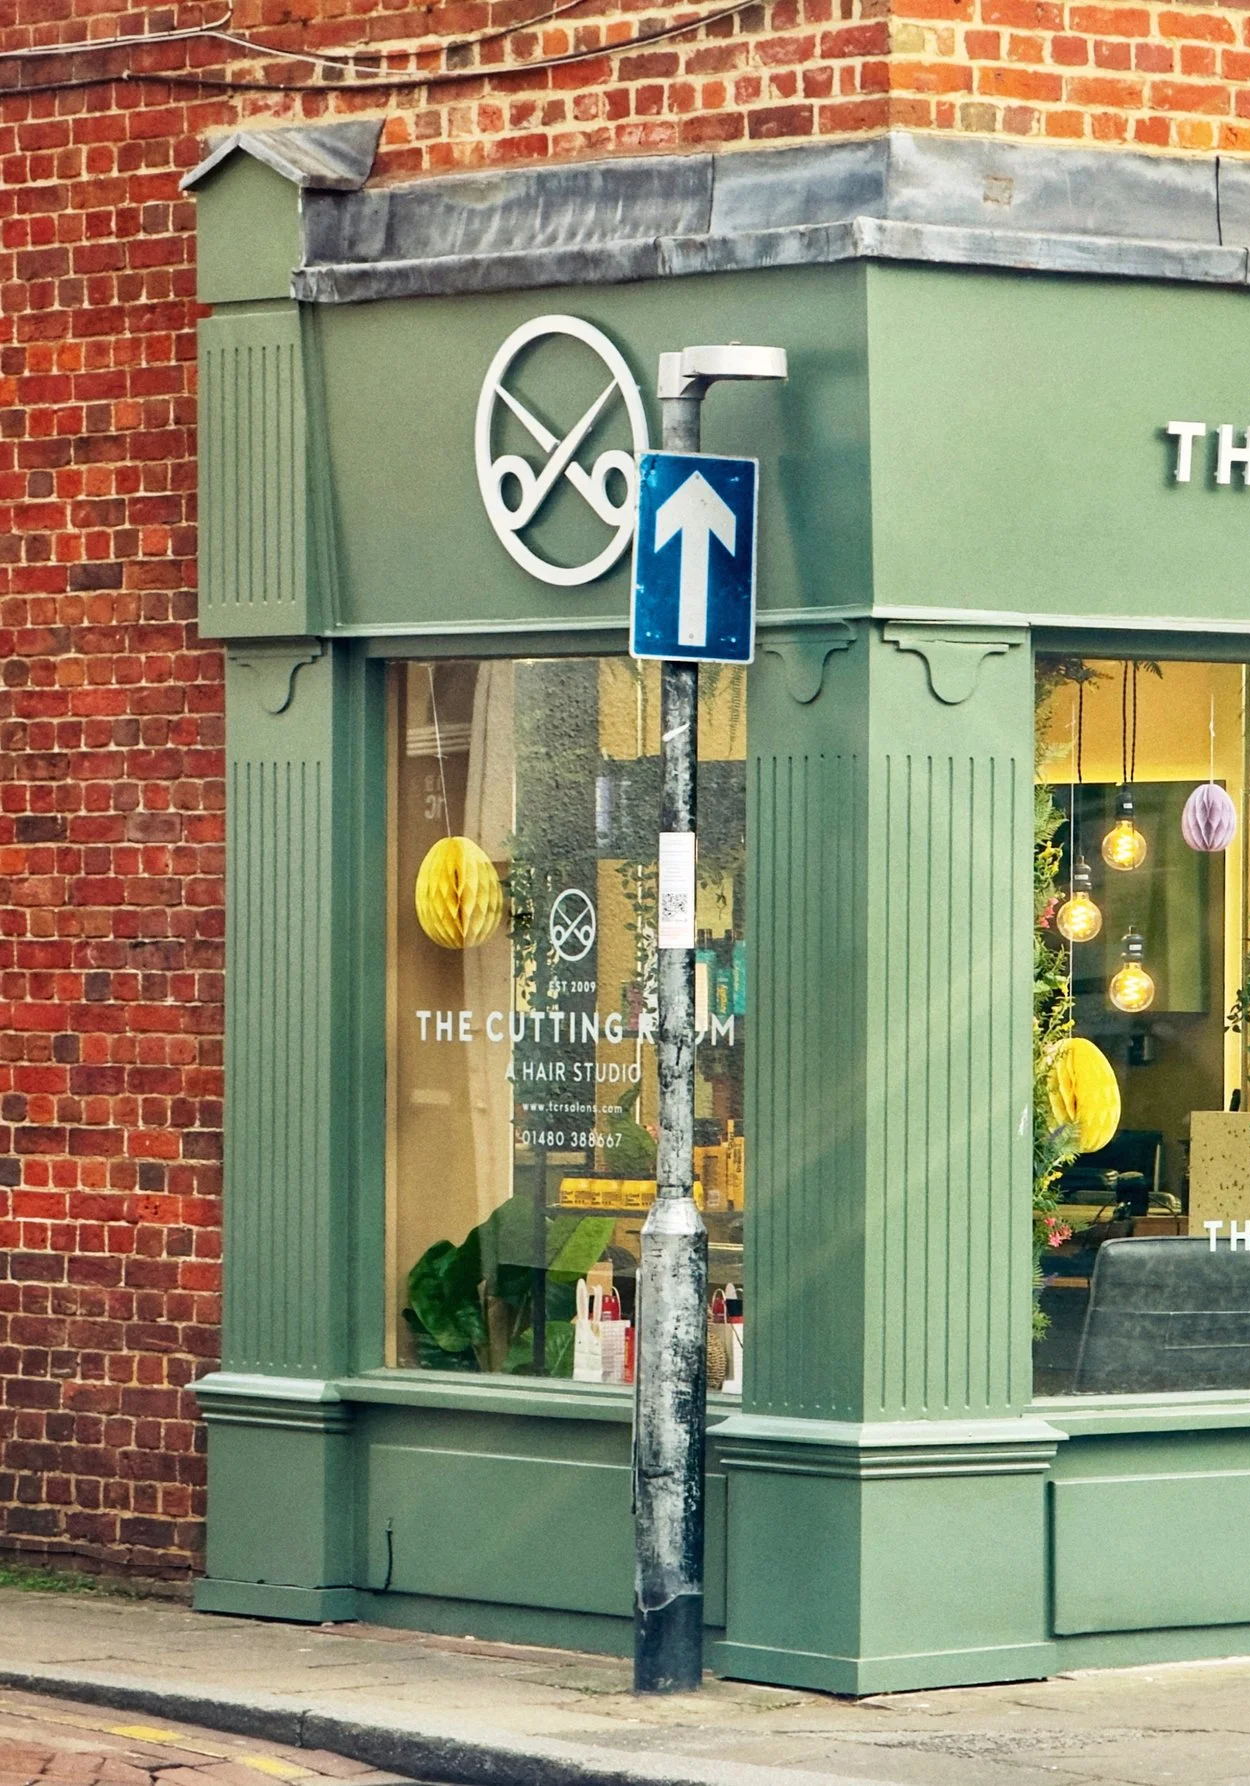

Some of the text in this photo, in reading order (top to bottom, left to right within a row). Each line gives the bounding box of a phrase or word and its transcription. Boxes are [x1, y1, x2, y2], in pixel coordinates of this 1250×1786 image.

[549, 981, 596, 993] EST 2009
[416, 1010, 735, 1046] THE CUTTING RM
[504, 1061, 642, 1083] A HAIR STUDIO
[522, 1101, 623, 1114] www.tcrsalons.com
[522, 1130, 622, 1148] 01480 388667
